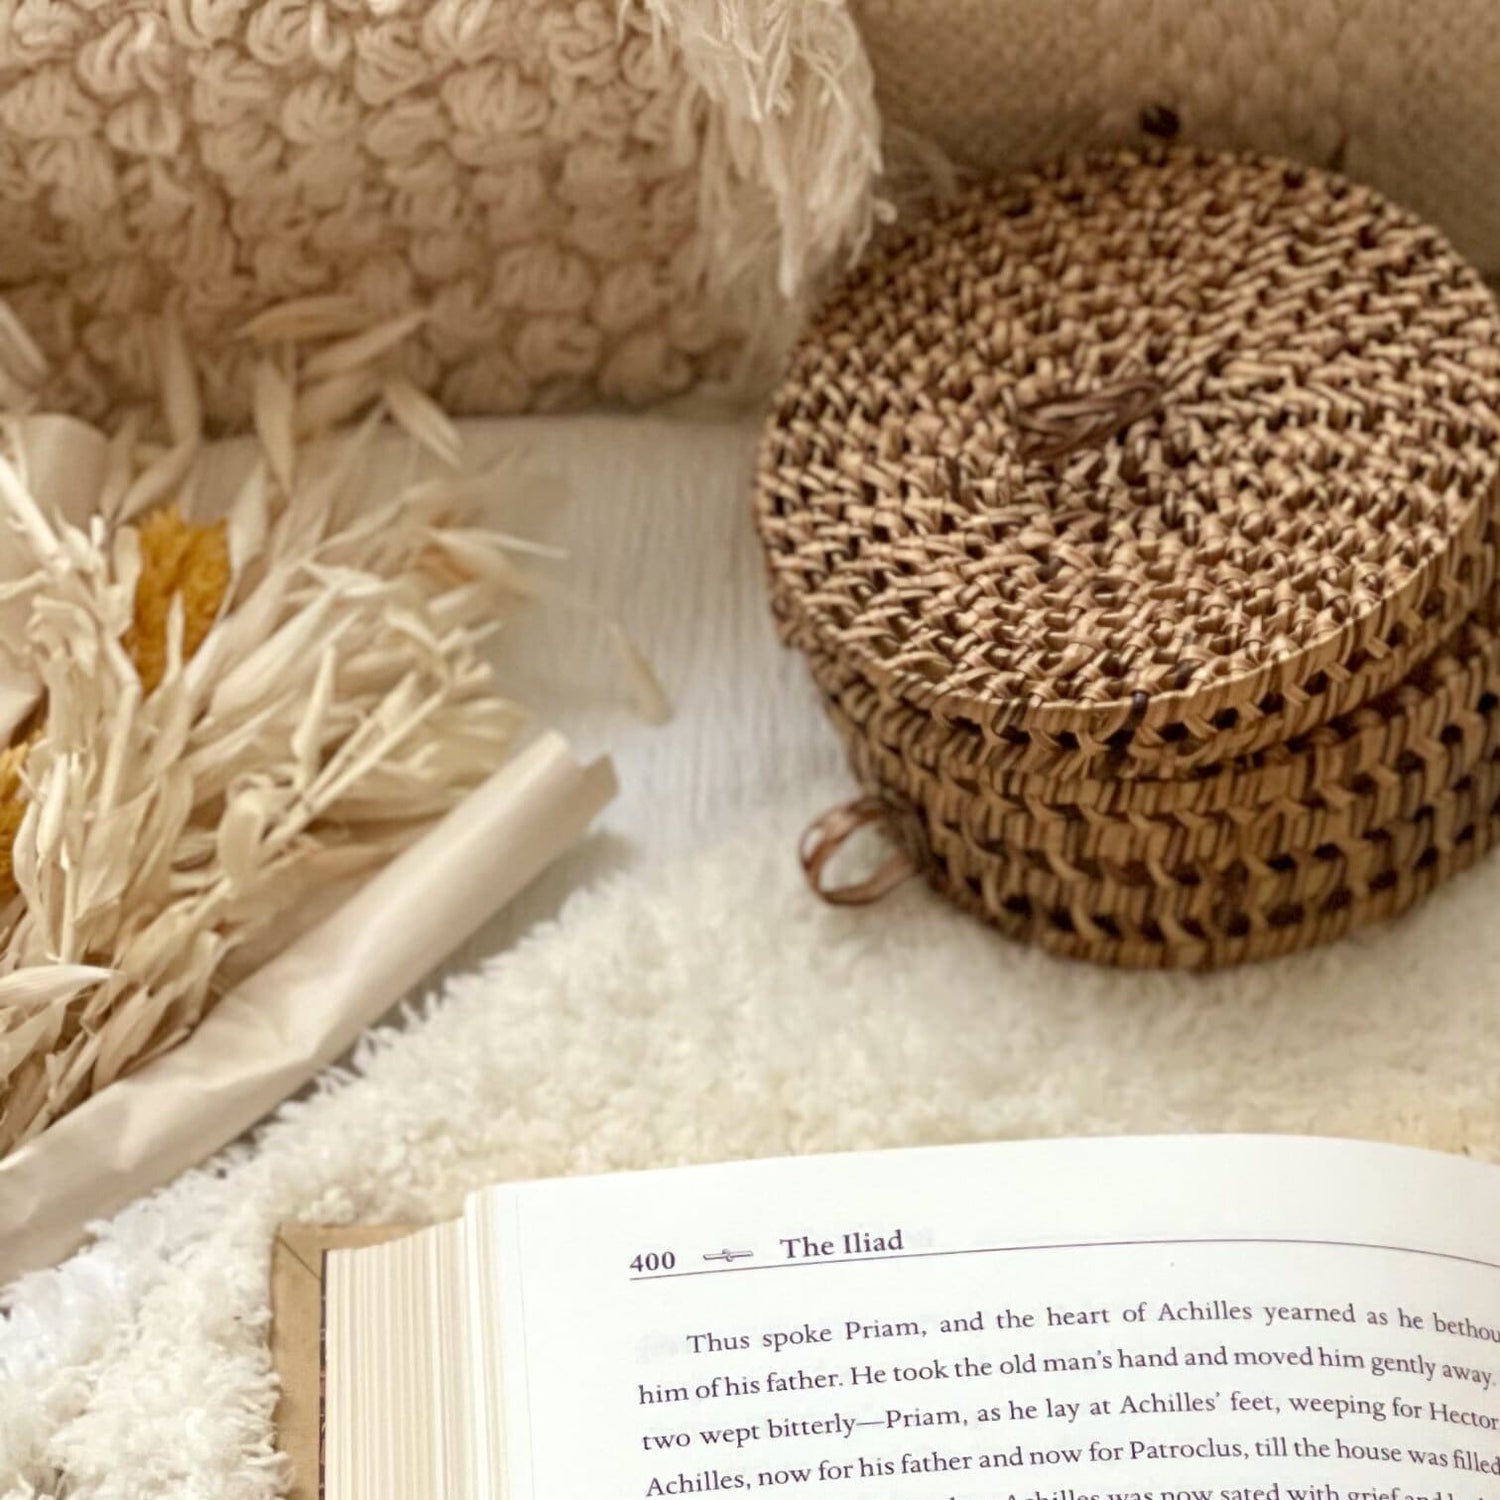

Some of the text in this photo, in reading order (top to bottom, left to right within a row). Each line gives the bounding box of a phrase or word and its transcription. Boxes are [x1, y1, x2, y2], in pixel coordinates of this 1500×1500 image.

[629, 1228, 905, 1273] 400 The Iliad
[685, 1332, 750, 1354] Thus
[762, 1323, 833, 1353] spoke
[844, 1319, 927, 1341] Priam,
[939, 1310, 985, 1334] and
[996, 1308, 1035, 1330] the
[1046, 1306, 1111, 1327] heart
[1122, 1301, 1148, 1323] of
[1157, 1299, 1253, 1322] Achilles
[1263, 1302, 1357, 1327] yearned
[1366, 1311, 1389, 1326] as
[1397, 1307, 1424, 1330] he
